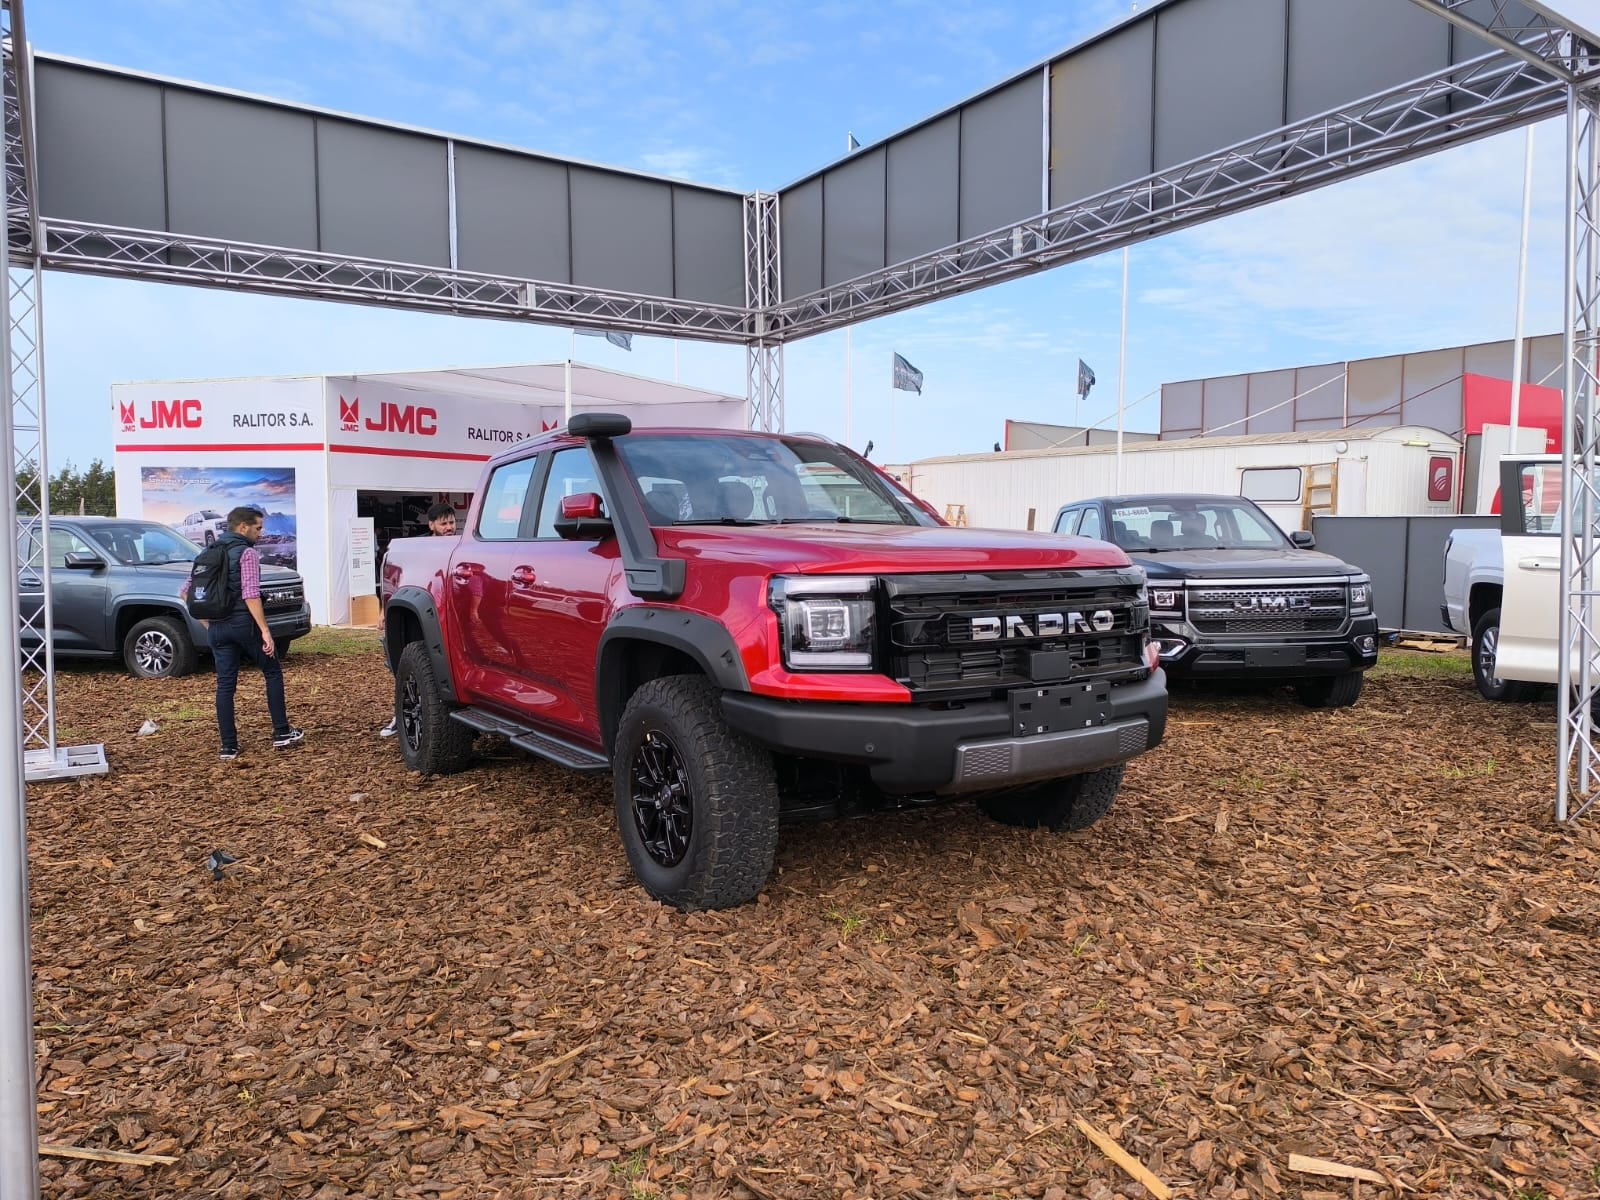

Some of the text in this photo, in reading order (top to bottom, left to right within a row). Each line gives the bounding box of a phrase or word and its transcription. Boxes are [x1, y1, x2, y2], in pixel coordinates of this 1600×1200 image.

[140, 400, 203, 428] JMC
[233, 412, 314, 428] RALITOR S.A.
[365, 401, 438, 436] JMC
[340, 424, 360, 432] JMC
[468, 427, 514, 443] RALITOR
[1234, 597, 1312, 612] JMC
